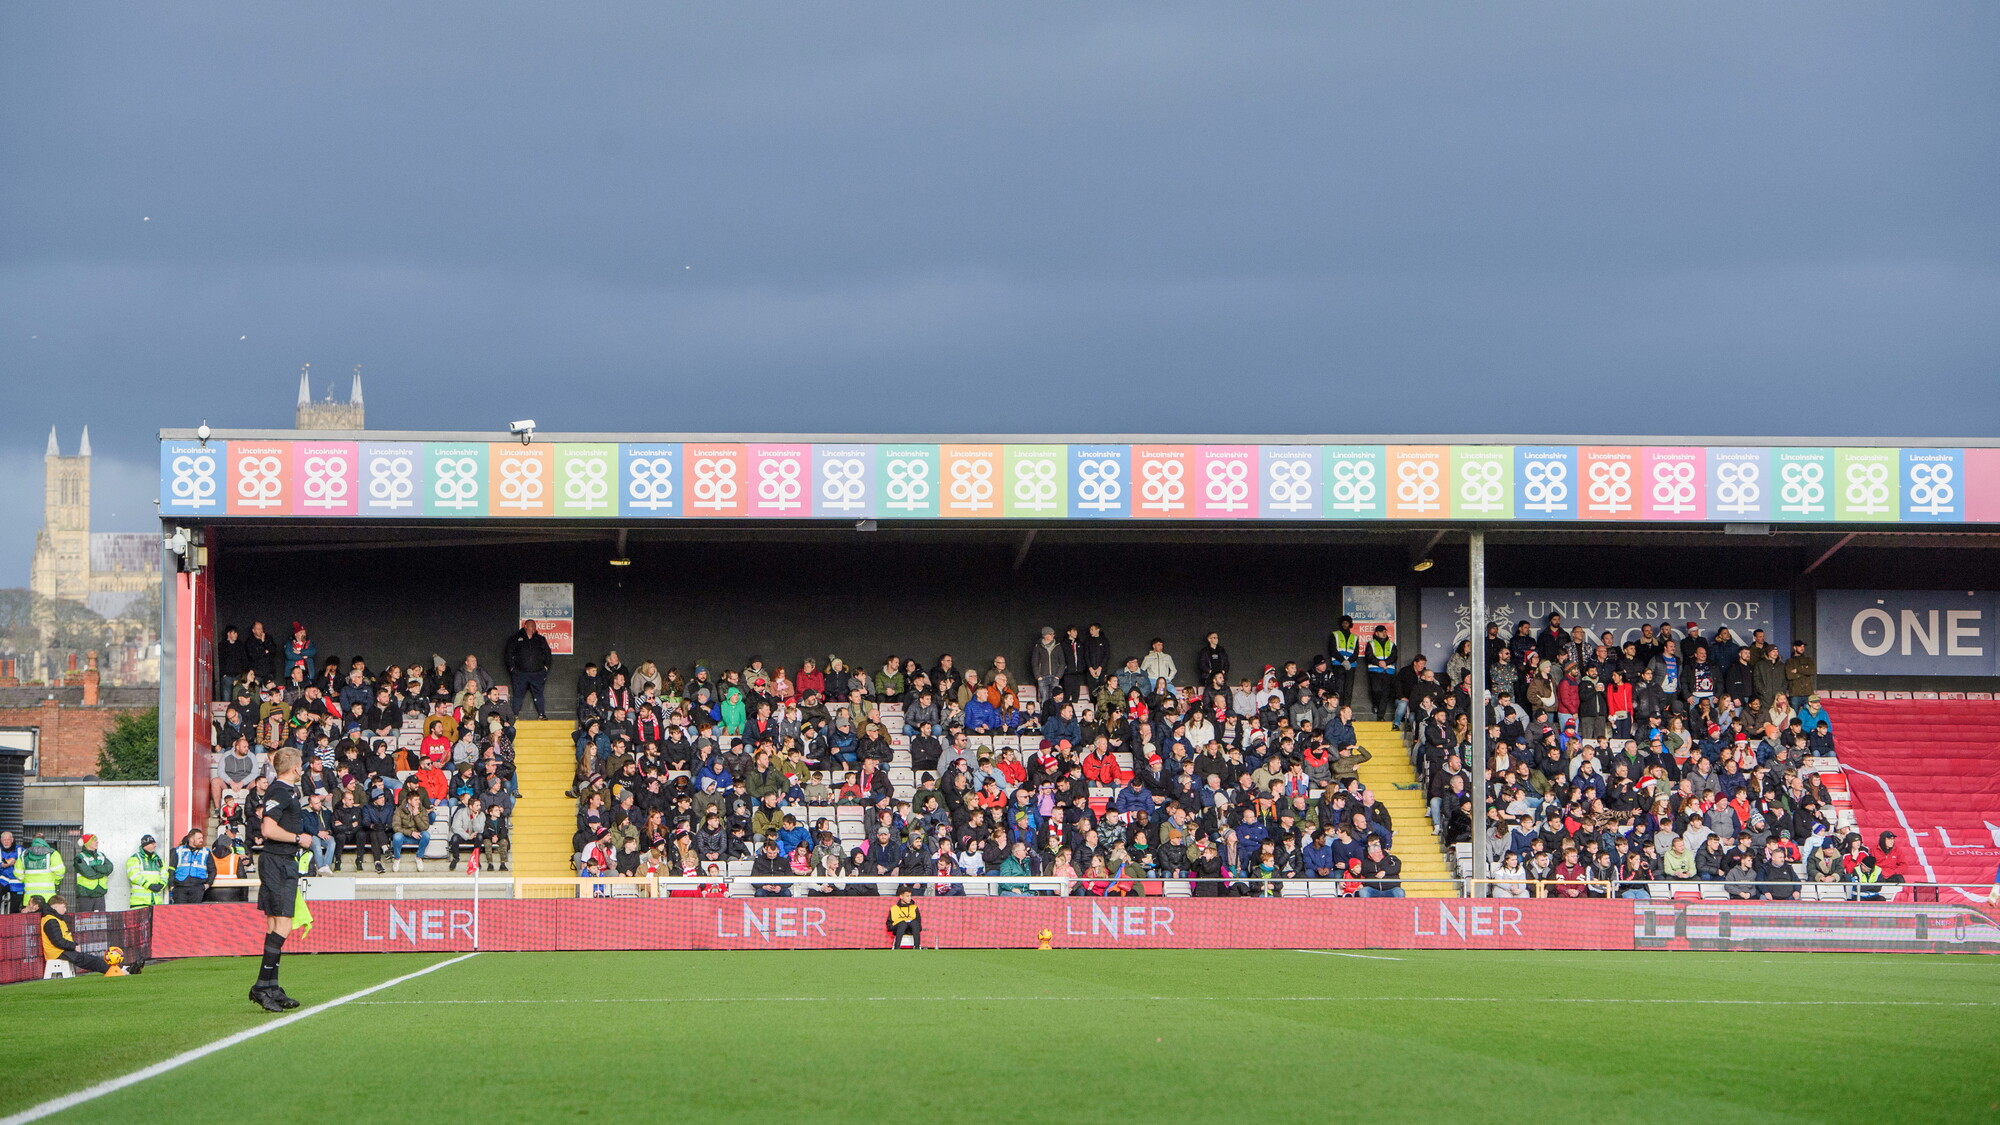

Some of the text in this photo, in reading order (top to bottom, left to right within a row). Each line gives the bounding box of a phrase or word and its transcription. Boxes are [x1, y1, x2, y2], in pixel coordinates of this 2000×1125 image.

[171, 446, 216, 454] Lincolnshire
[237, 447, 282, 455] Lincolnshire
[303, 447, 348, 455] Lincolnshire
[368, 447, 414, 455] Lincolnshire
[434, 448, 479, 456] Lincolnshire
[499, 449, 543, 457] Lincolnshire
[564, 448, 609, 456] Lincolnshire
[629, 449, 673, 457] Lincolnshire
[693, 449, 737, 457] Lincolnshire
[757, 449, 801, 457] Lincolnshire
[822, 449, 866, 457] Lincolnshire
[886, 449, 930, 457] Lincolnshire
[950, 450, 993, 458] Lincolnshire
[1014, 450, 1058, 458] Lincolnshire
[1078, 450, 1121, 458] Lincolnshire
[1141, 450, 1185, 458] Lincolnshire
[1269, 450, 1313, 458] Lincolnshire
[1205, 451, 1249, 459] Lincolnshire
[1333, 451, 1376, 459] Lincolnshire
[1397, 451, 1441, 459] Lincolnshire
[1460, 451, 1505, 459] Lincolnshire
[1524, 452, 1568, 460] Lincolnshire
[1589, 452, 1632, 460] Lincolnshire
[1652, 453, 1696, 461] Lincolnshire
[1716, 452, 1761, 460] Lincolnshire
[1781, 453, 1825, 461] Lincolnshire
[1845, 453, 1890, 461] Lincolnshire
[1910, 454, 1954, 462] Lincolnshire
[1526, 601, 1760, 620] UNIVERSITY OF
[1851, 608, 1983, 656] ONE
[364, 903, 474, 945] LNER
[717, 901, 827, 942] LNER
[1066, 900, 1175, 941] LNER
[1414, 900, 1523, 941] LNER
